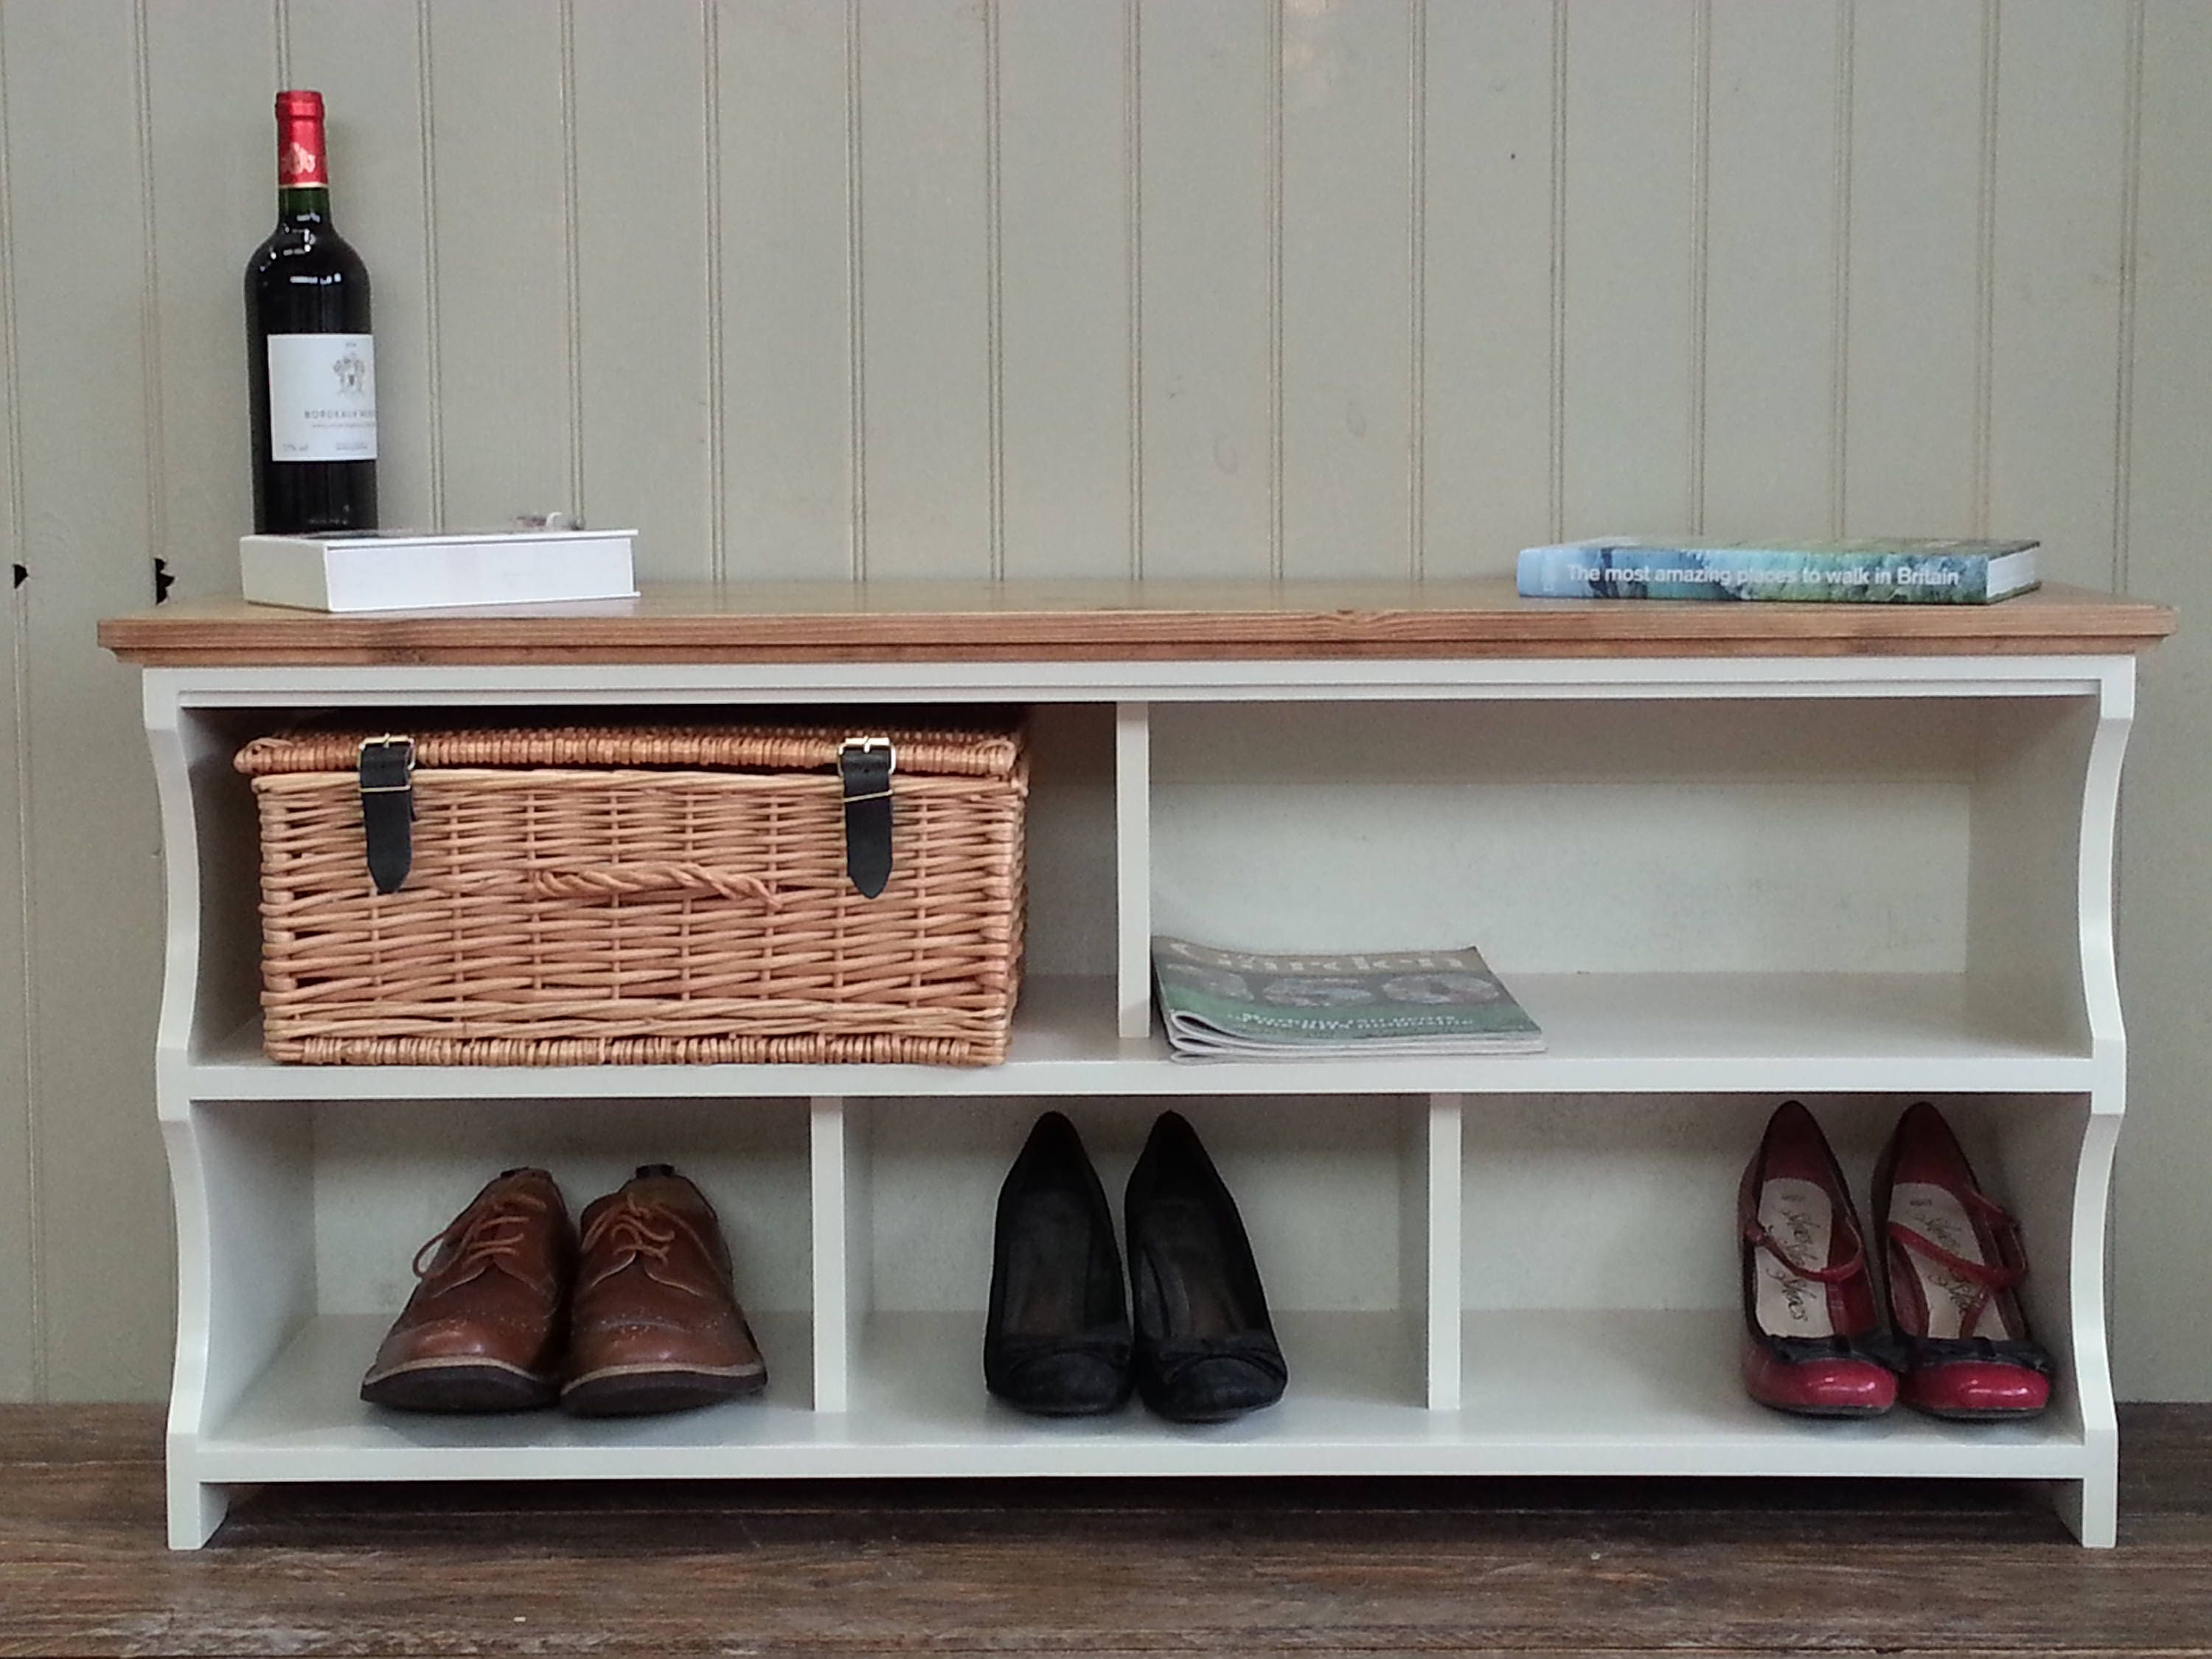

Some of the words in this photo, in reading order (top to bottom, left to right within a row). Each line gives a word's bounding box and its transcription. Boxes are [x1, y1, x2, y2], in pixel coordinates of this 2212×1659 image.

[1568, 565, 1600, 582] The
[1605, 566, 1650, 582] most
[1655, 568, 1732, 586] amazing
[1736, 568, 1797, 588] places
[1803, 566, 1821, 583] to
[1826, 566, 1870, 585] walk
[1875, 567, 1892, 585] in
[1897, 566, 1959, 585] Britain
